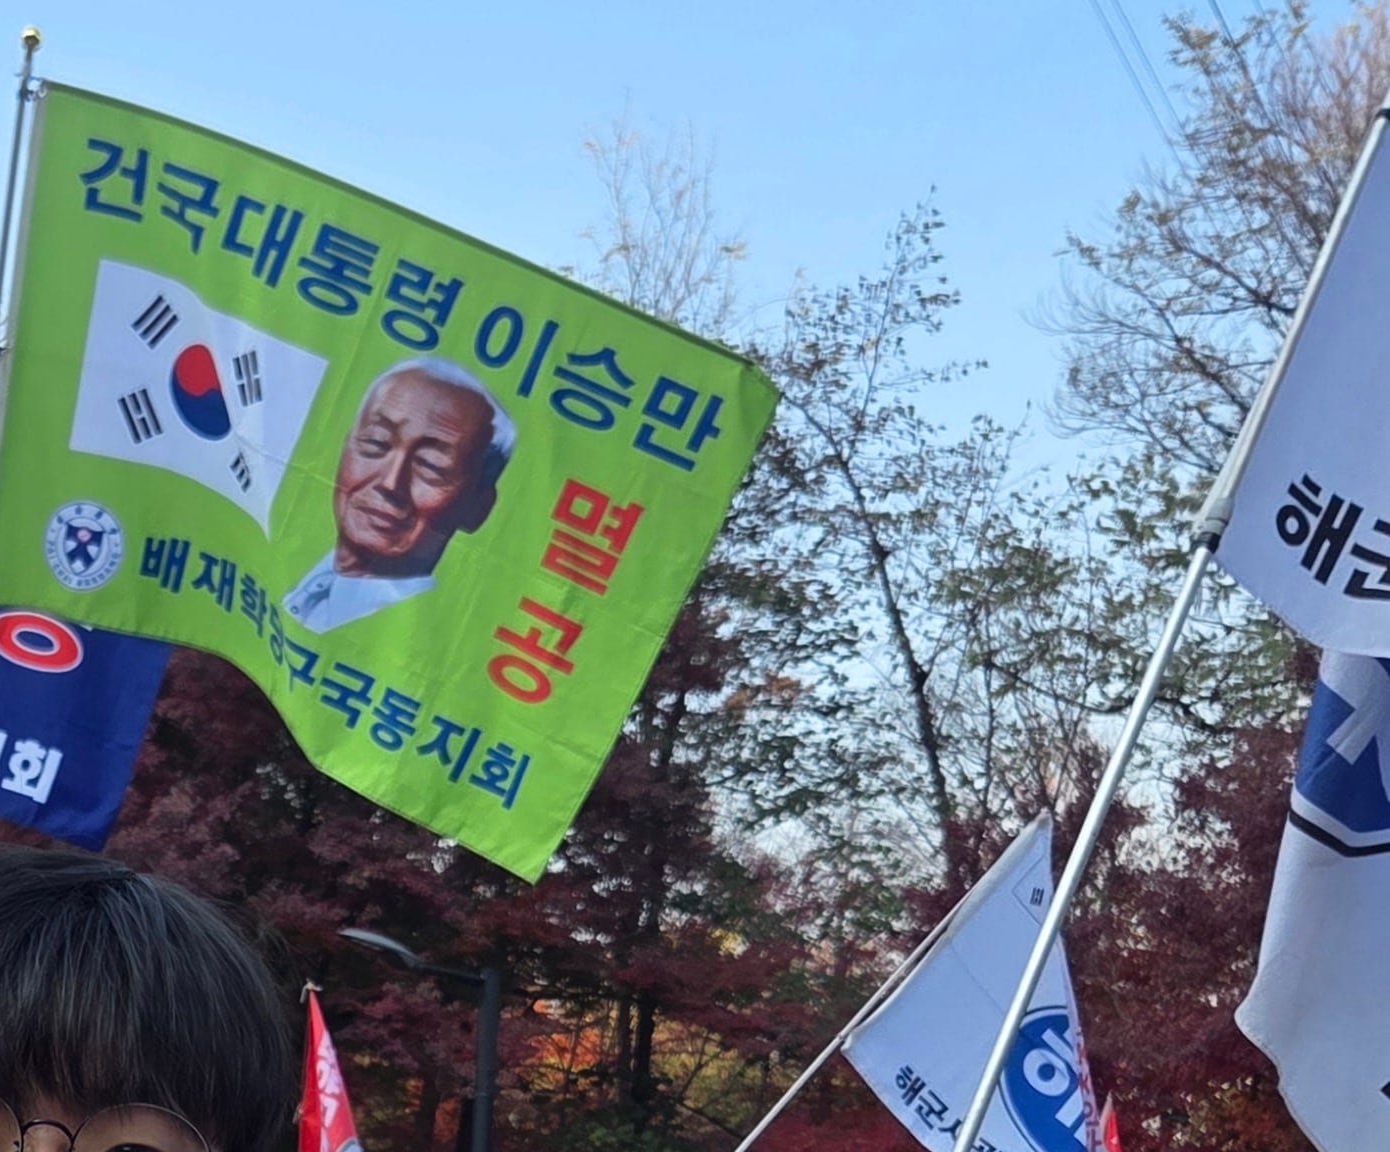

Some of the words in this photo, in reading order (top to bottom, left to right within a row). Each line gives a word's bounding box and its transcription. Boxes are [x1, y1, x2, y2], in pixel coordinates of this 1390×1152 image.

[79, 138, 465, 352] 건국대통령
[473, 305, 724, 473] 이승만
[139, 536, 531, 810] 배재학당구국동지회
[486, 477, 646, 705] 멸공
